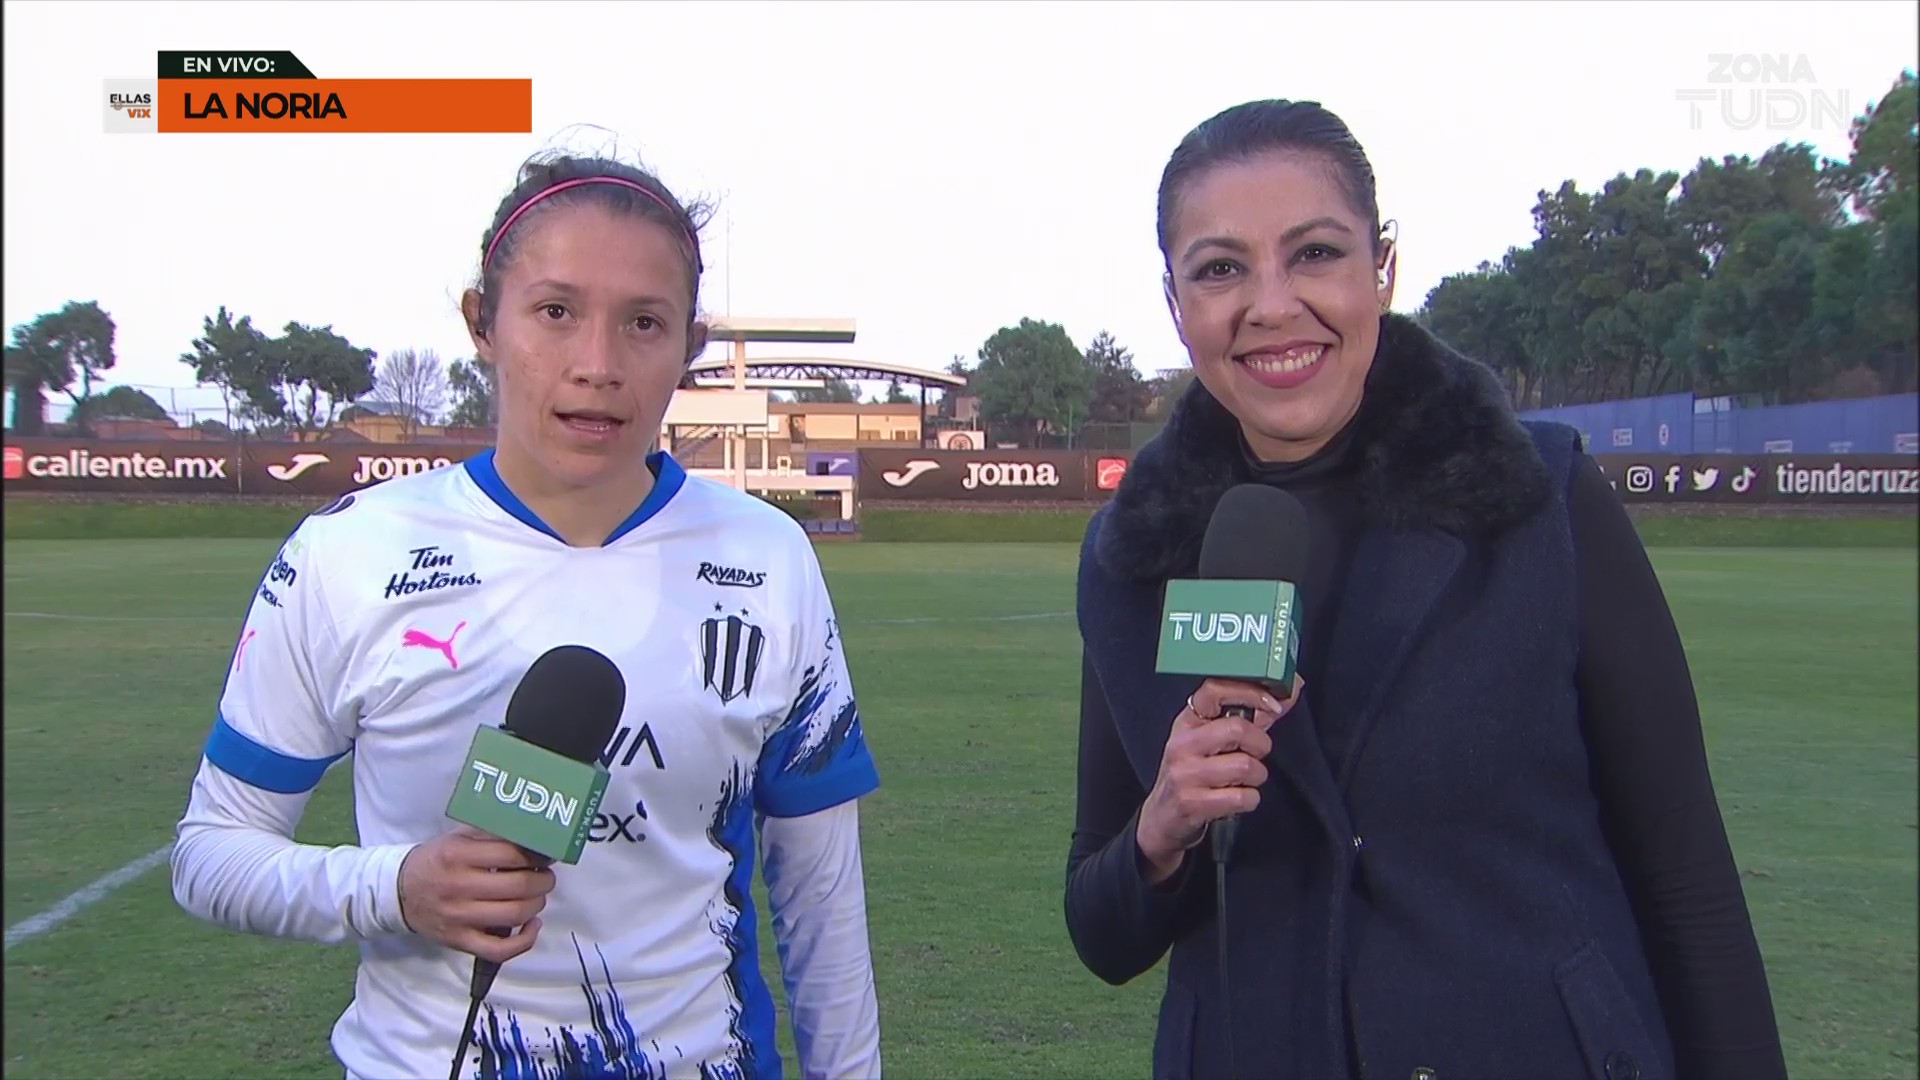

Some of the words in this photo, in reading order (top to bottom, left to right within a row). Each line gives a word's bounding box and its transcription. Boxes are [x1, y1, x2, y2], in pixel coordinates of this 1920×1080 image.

[27, 449, 227, 479] caliente.mx
[409, 546, 453, 570] Tim
[1168, 612, 1268, 644] TUDN
[471, 760, 577, 826] TUDN
